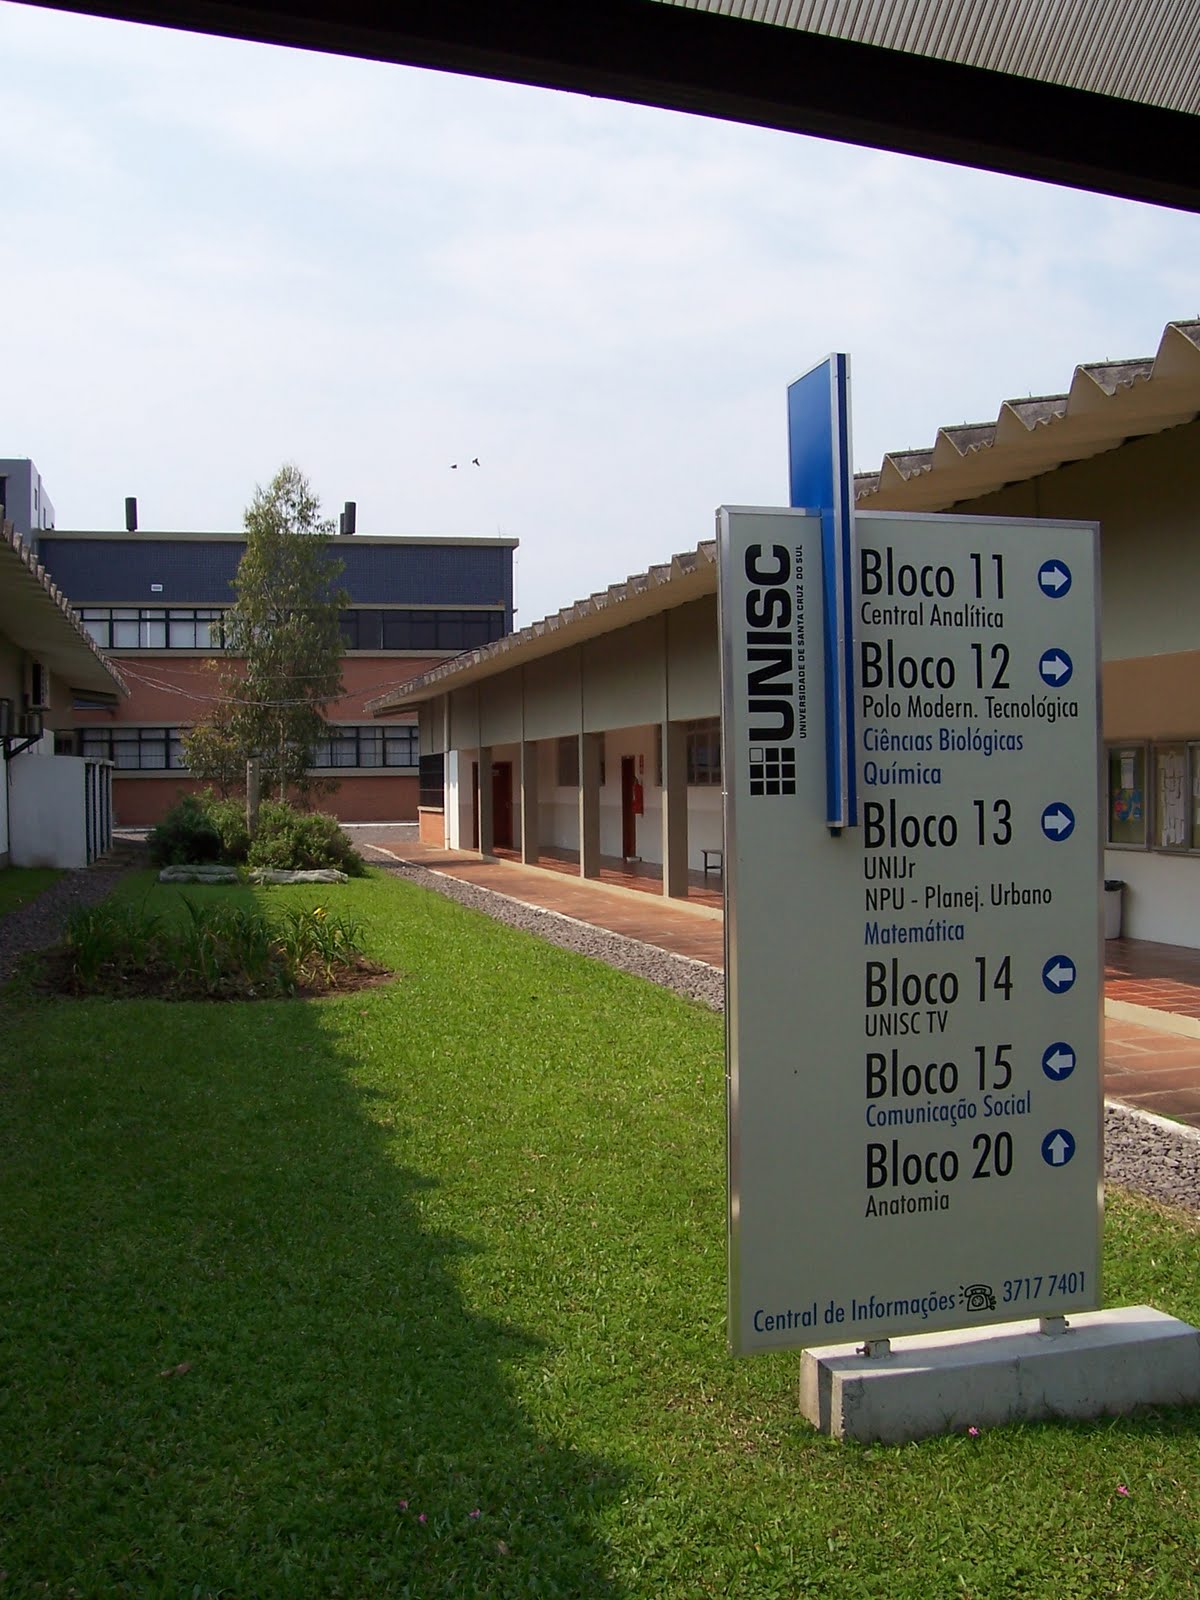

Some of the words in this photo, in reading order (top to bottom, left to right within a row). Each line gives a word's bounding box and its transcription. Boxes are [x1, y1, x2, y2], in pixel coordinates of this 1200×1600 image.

[796, 565, 804, 579] DO
[861, 547, 954, 597] Bloco
[970, 553, 1005, 599] 11
[797, 613, 805, 646] SANTA
[861, 602, 923, 625] Central
[930, 603, 1003, 628] Analítica
[745, 544, 794, 741] UNISC
[798, 648, 806, 661] DE
[861, 639, 955, 689] Bloco
[971, 643, 1009, 689] 12
[798, 664, 807, 738] UNIVERSIDADE
[863, 694, 900, 718] Polo
[908, 695, 978, 718] Modern.
[984, 694, 1078, 723] Tecnológica
[940, 728, 1023, 756] Biológicas
[864, 761, 941, 786] Química
[864, 799, 957, 848] Bloco
[974, 799, 1011, 845] 13
[865, 856, 915, 879] UNIJr
[866, 887, 904, 911] NPU
[926, 885, 983, 912] Planej.
[991, 882, 1052, 906] Urbano
[865, 921, 964, 945] Matemática
[866, 957, 958, 1007] Bloco
[975, 956, 1013, 1001] 14
[866, 1012, 920, 1036] UNISC
[926, 1010, 948, 1033] TV
[866, 1049, 958, 1099] Bloco
[975, 1044, 1012, 1090] 15
[866, 1097, 976, 1127] Comunicação
[982, 1089, 1030, 1117] Social
[867, 1140, 958, 1189] Bloco
[972, 1132, 1012, 1179] 20
[865, 1190, 949, 1217] Anatomia
[1003, 1277, 1042, 1302] 3717
[1049, 1272, 1084, 1296] 7401
[754, 1303, 816, 1332] Central
[825, 1301, 844, 1324] de
[853, 1291, 955, 1320] Informações
